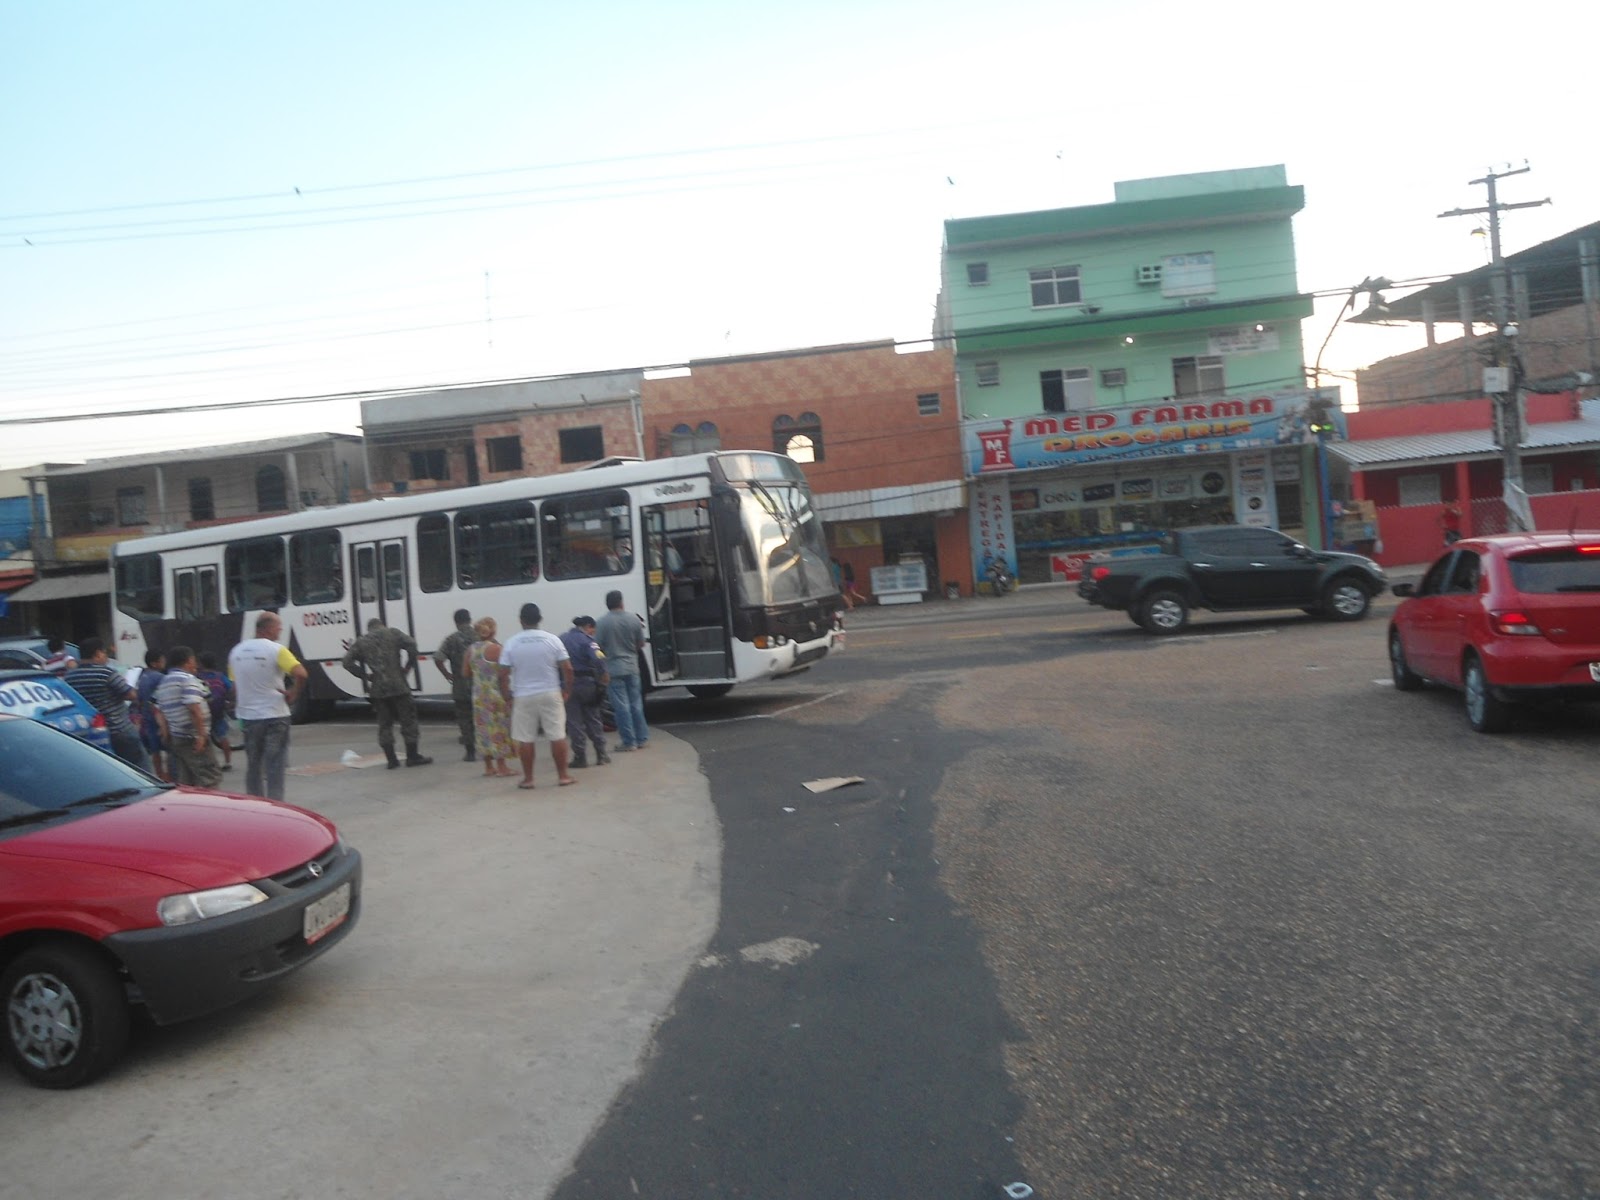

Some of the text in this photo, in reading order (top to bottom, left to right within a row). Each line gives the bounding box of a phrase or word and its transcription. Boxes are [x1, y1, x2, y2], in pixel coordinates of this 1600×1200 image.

[1024, 397, 1274, 438] MED FARMA
[1043, 420, 1252, 454] DROGARIA
